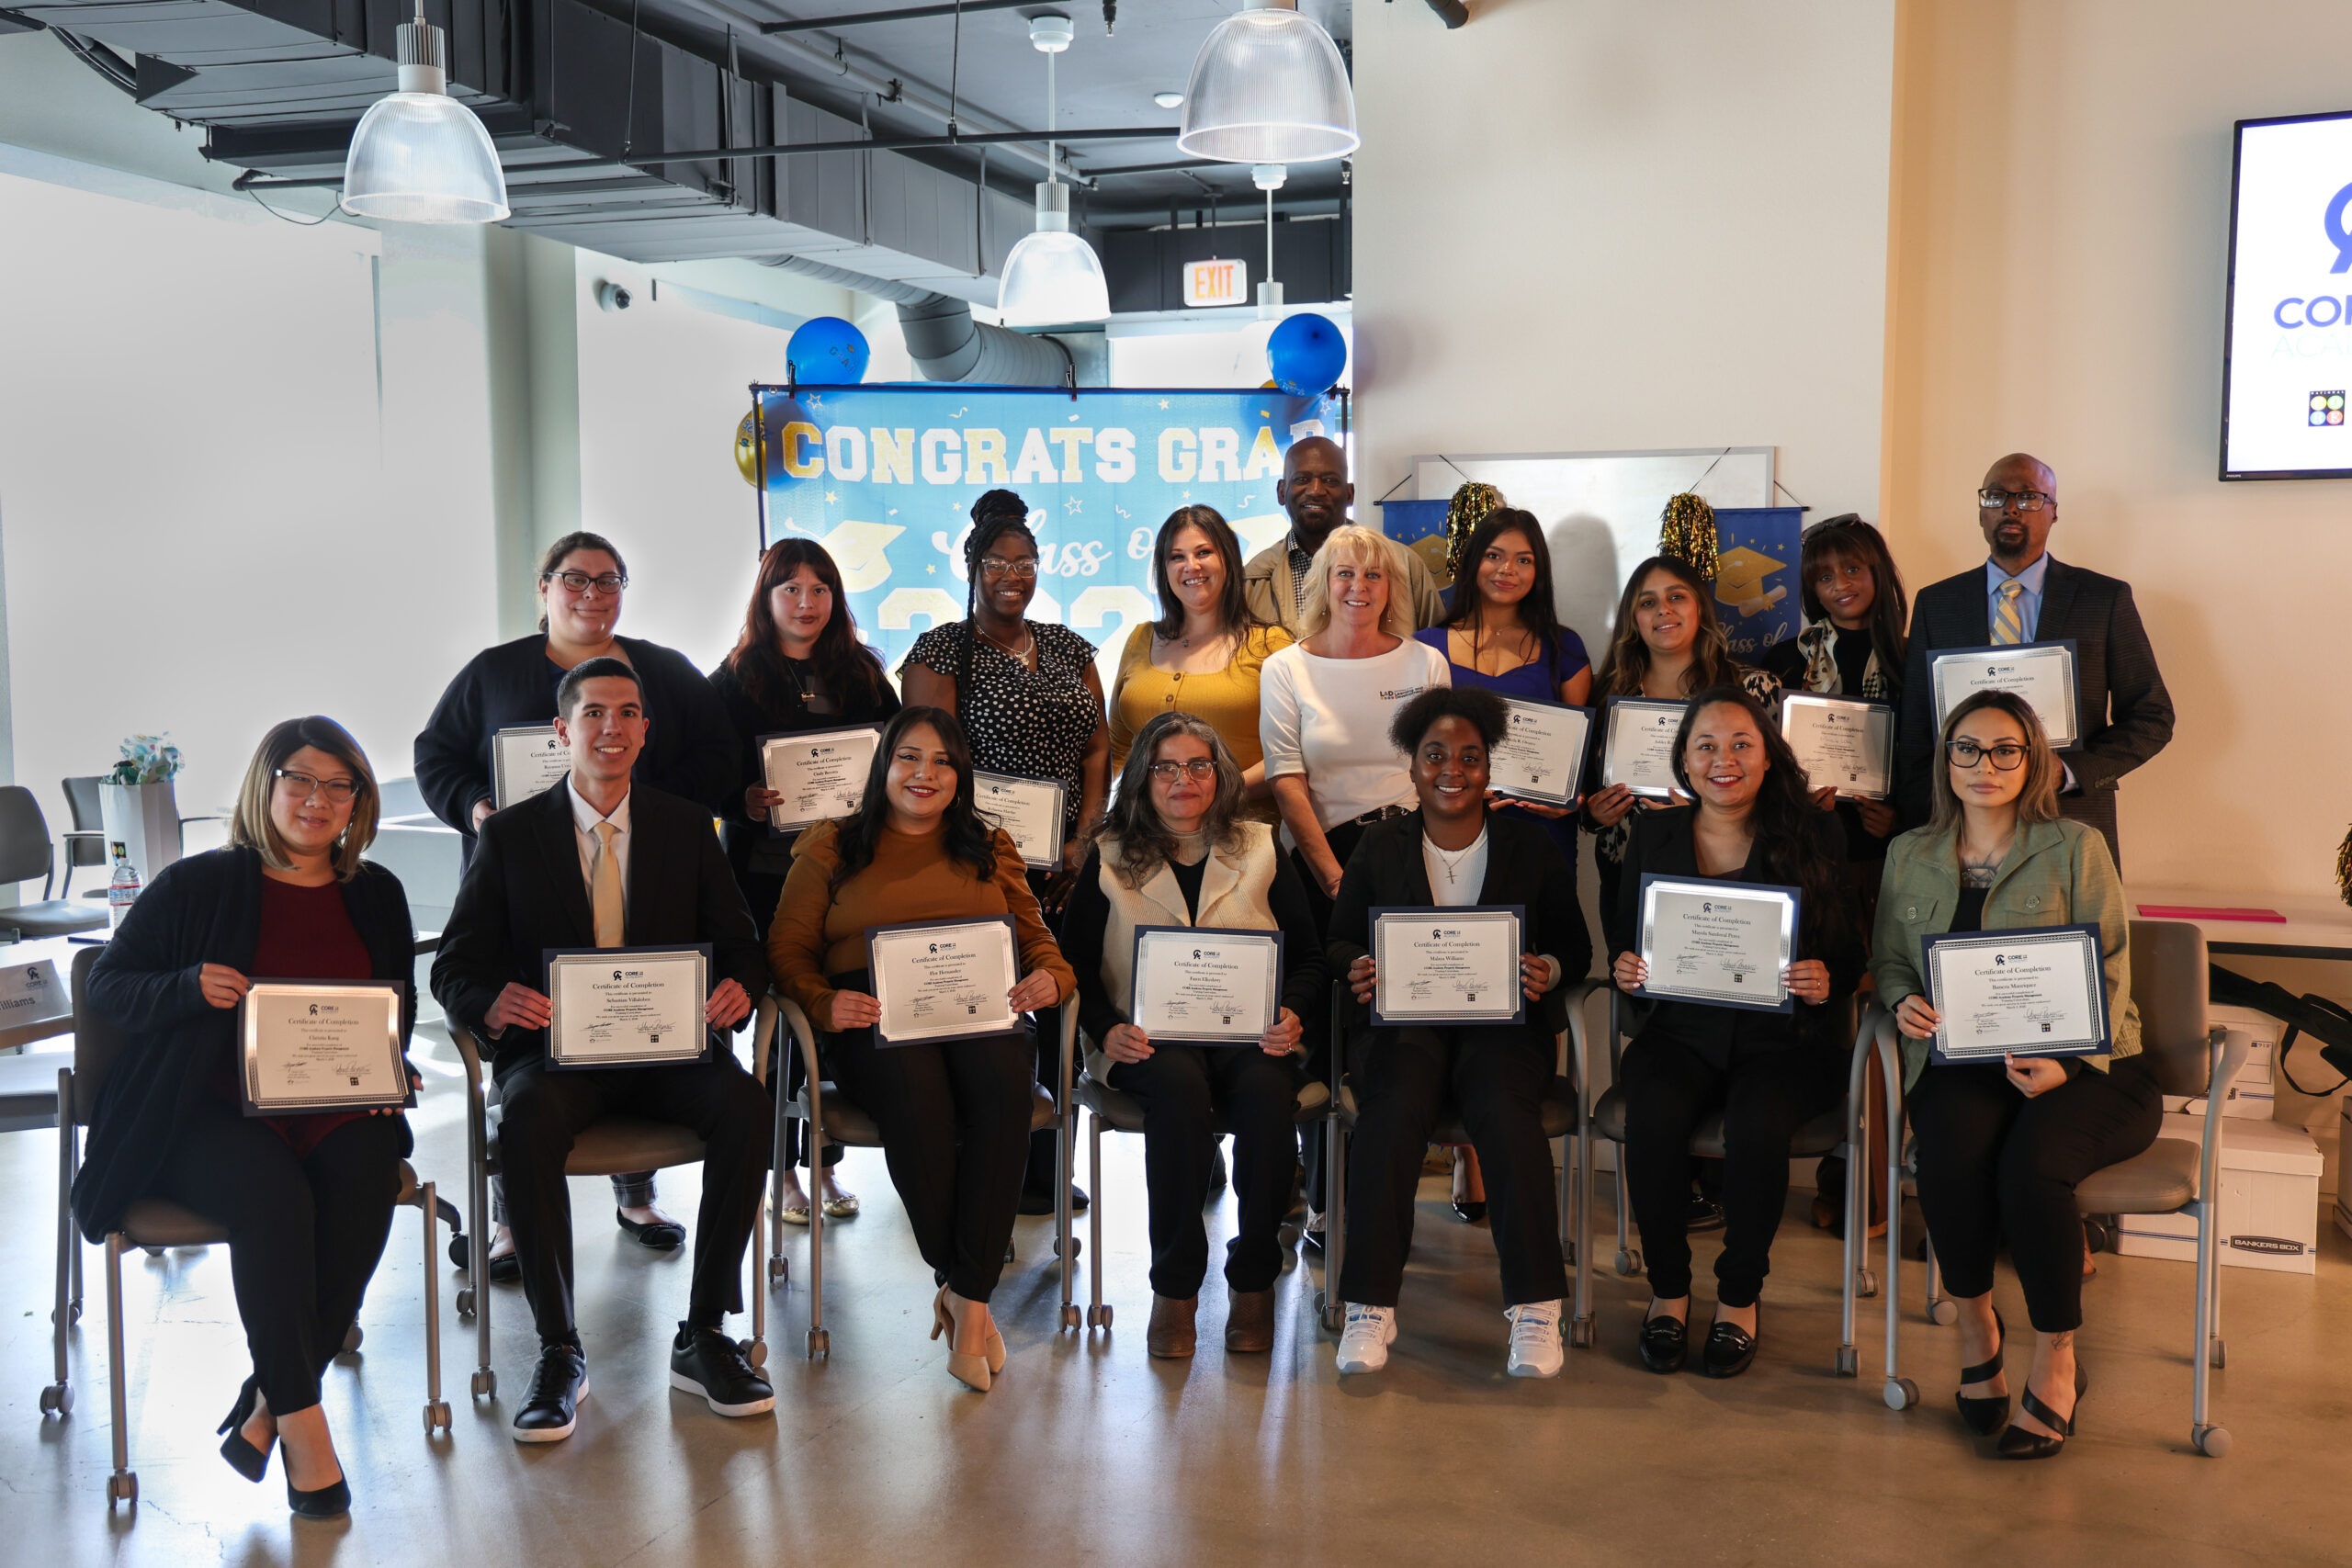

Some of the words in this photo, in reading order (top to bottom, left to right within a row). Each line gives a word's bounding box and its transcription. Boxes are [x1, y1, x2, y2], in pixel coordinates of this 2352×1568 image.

[1195, 265, 1234, 299] EXIT
[782, 420, 1136, 484] CONGRATS
[1683, 913, 1710, 922] Certificate
[1718, 917, 1751, 927] Completion
[945, 952, 976, 961] Completion
[1208, 962, 1238, 971] Completion
[2014, 965, 2051, 974] Completion
[0, 995, 36, 1010] illiams
[2234, 1239, 2278, 1249] BANKERS
